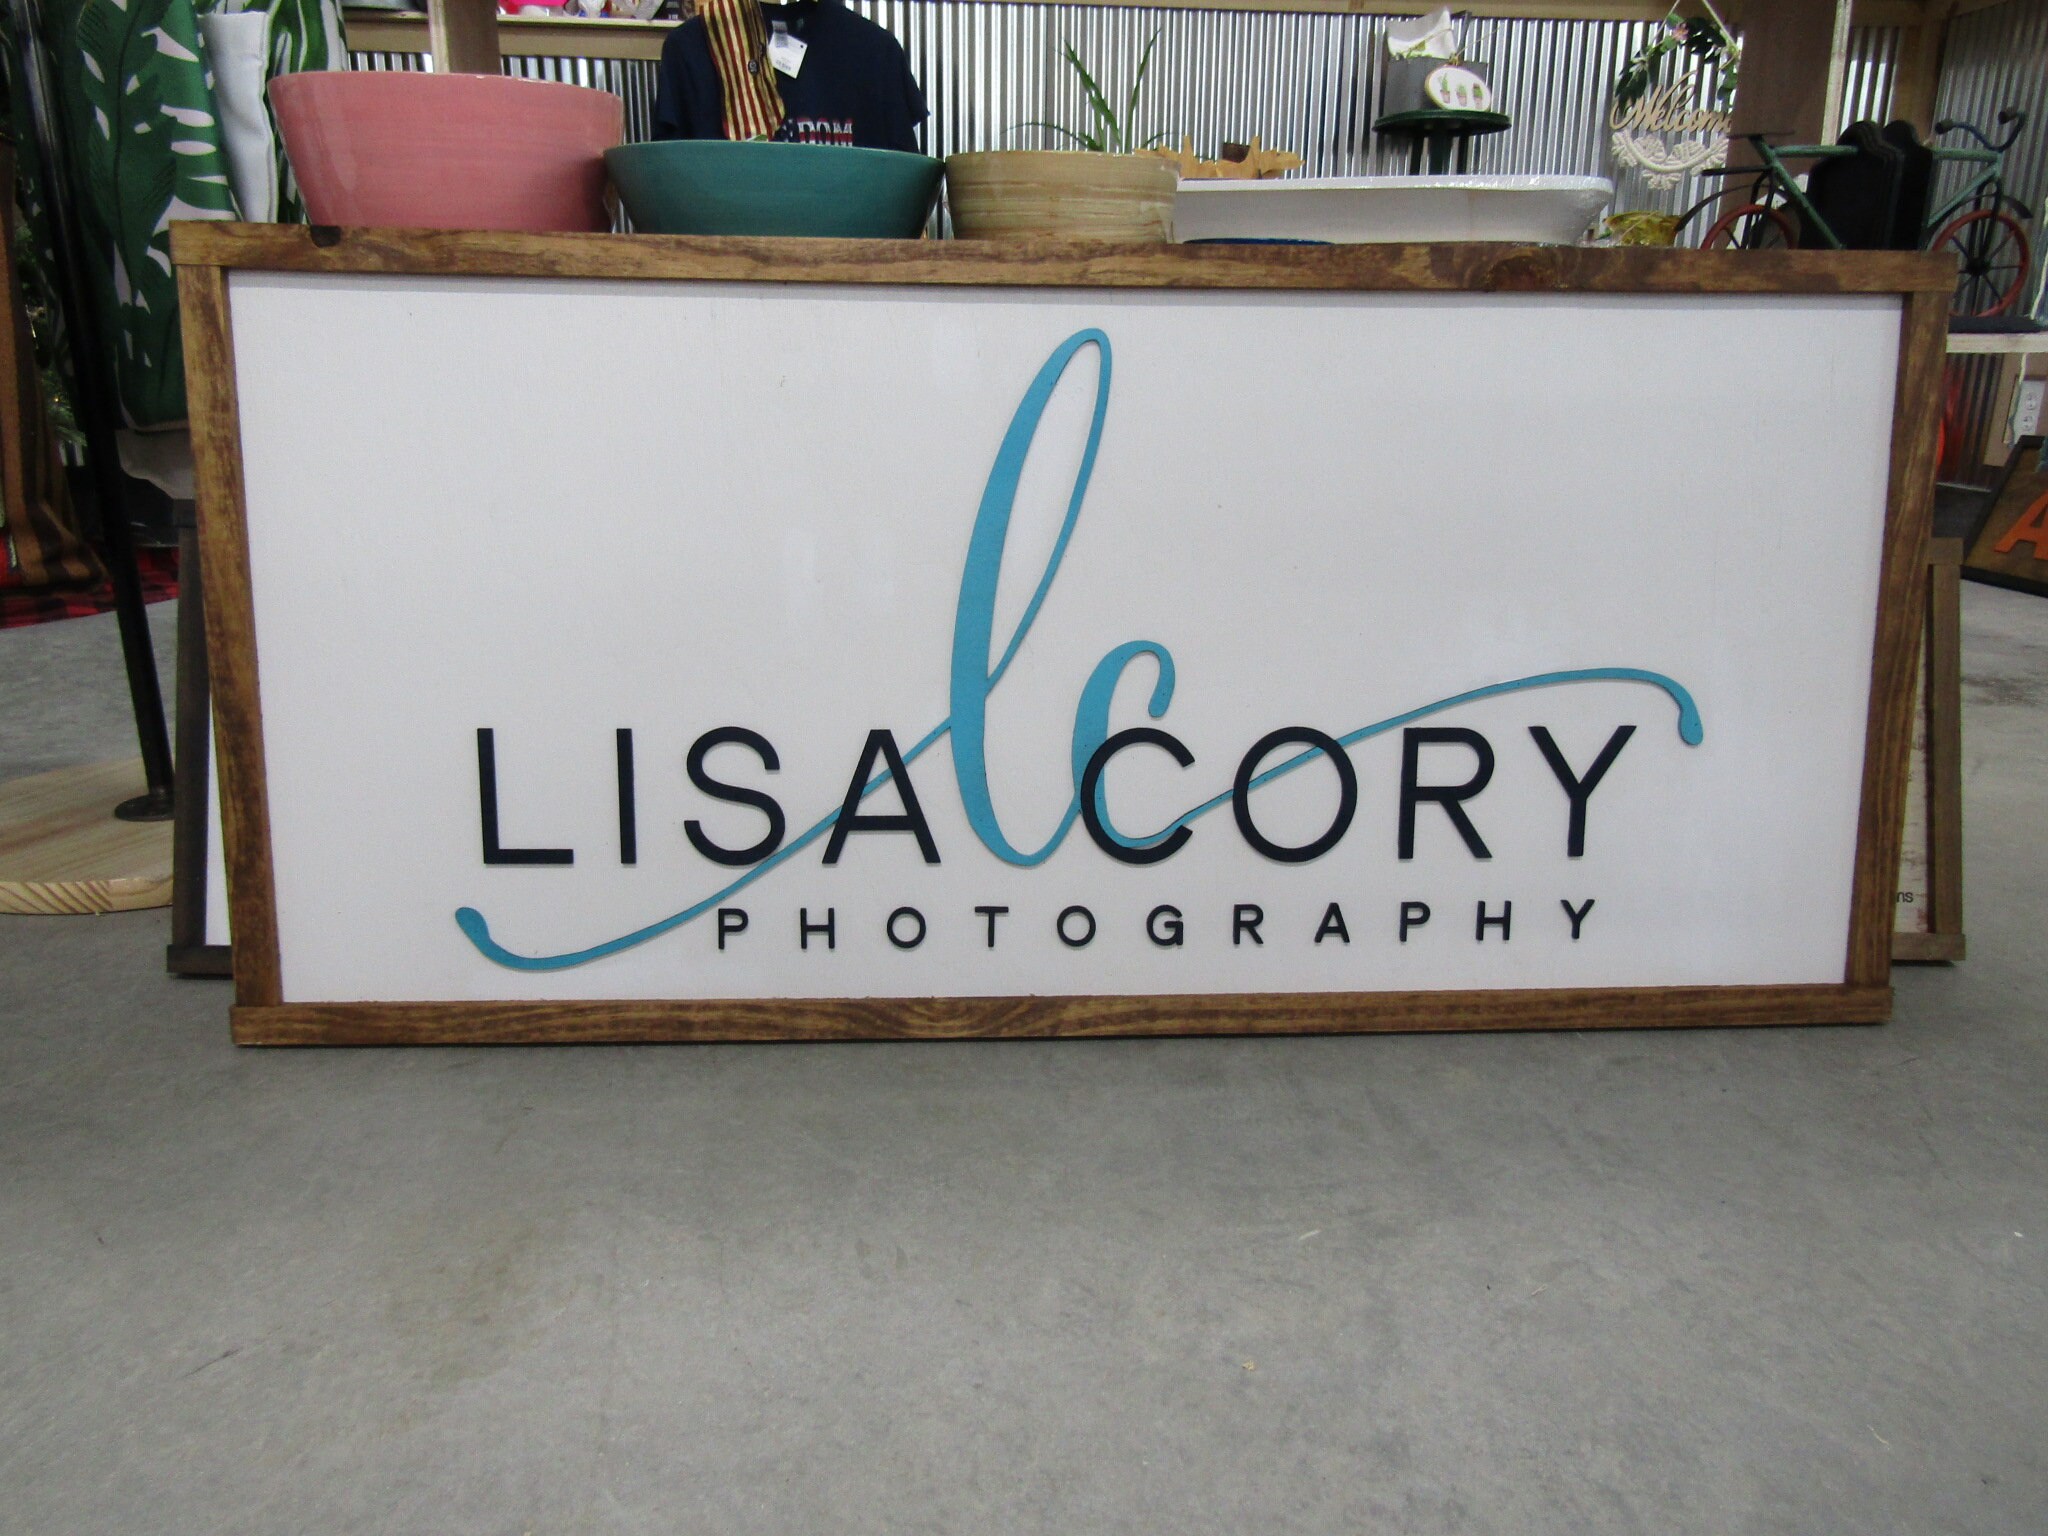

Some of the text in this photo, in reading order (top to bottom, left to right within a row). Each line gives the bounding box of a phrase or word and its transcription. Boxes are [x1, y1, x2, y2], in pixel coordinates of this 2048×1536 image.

[476, 725, 1637, 866] LISA CORY
[718, 898, 1596, 950] PHOTOGRAPHY
